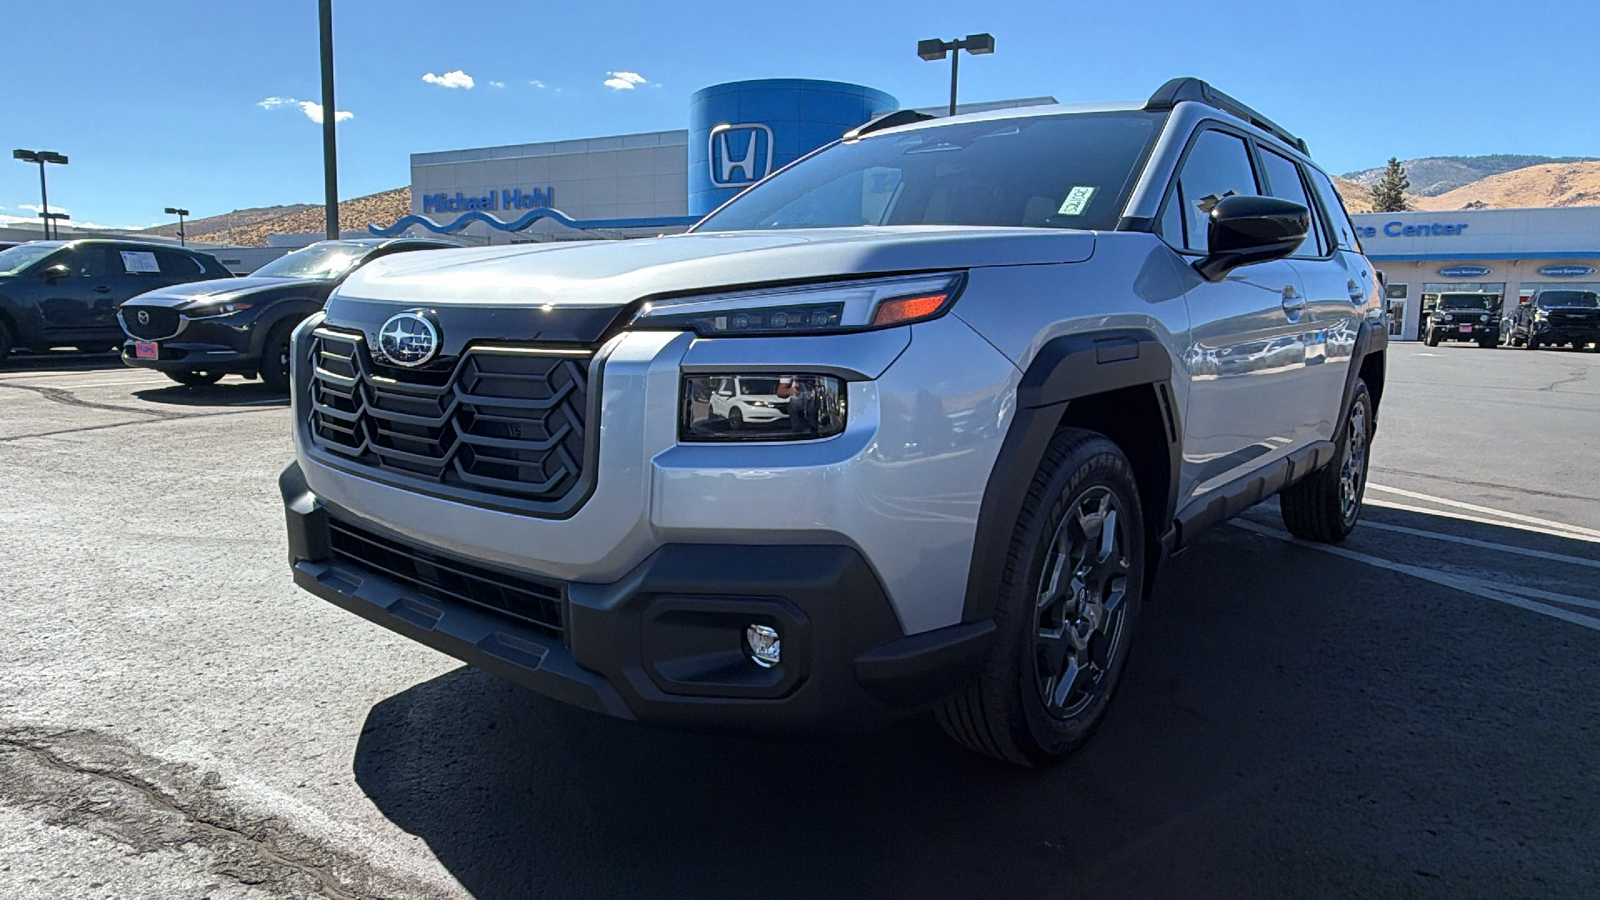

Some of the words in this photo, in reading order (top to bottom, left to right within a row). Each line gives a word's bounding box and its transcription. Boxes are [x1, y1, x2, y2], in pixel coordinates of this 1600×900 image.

[422, 190, 498, 214] Michael
[502, 186, 555, 210] Hohl
[1383, 221, 1469, 237] Center
